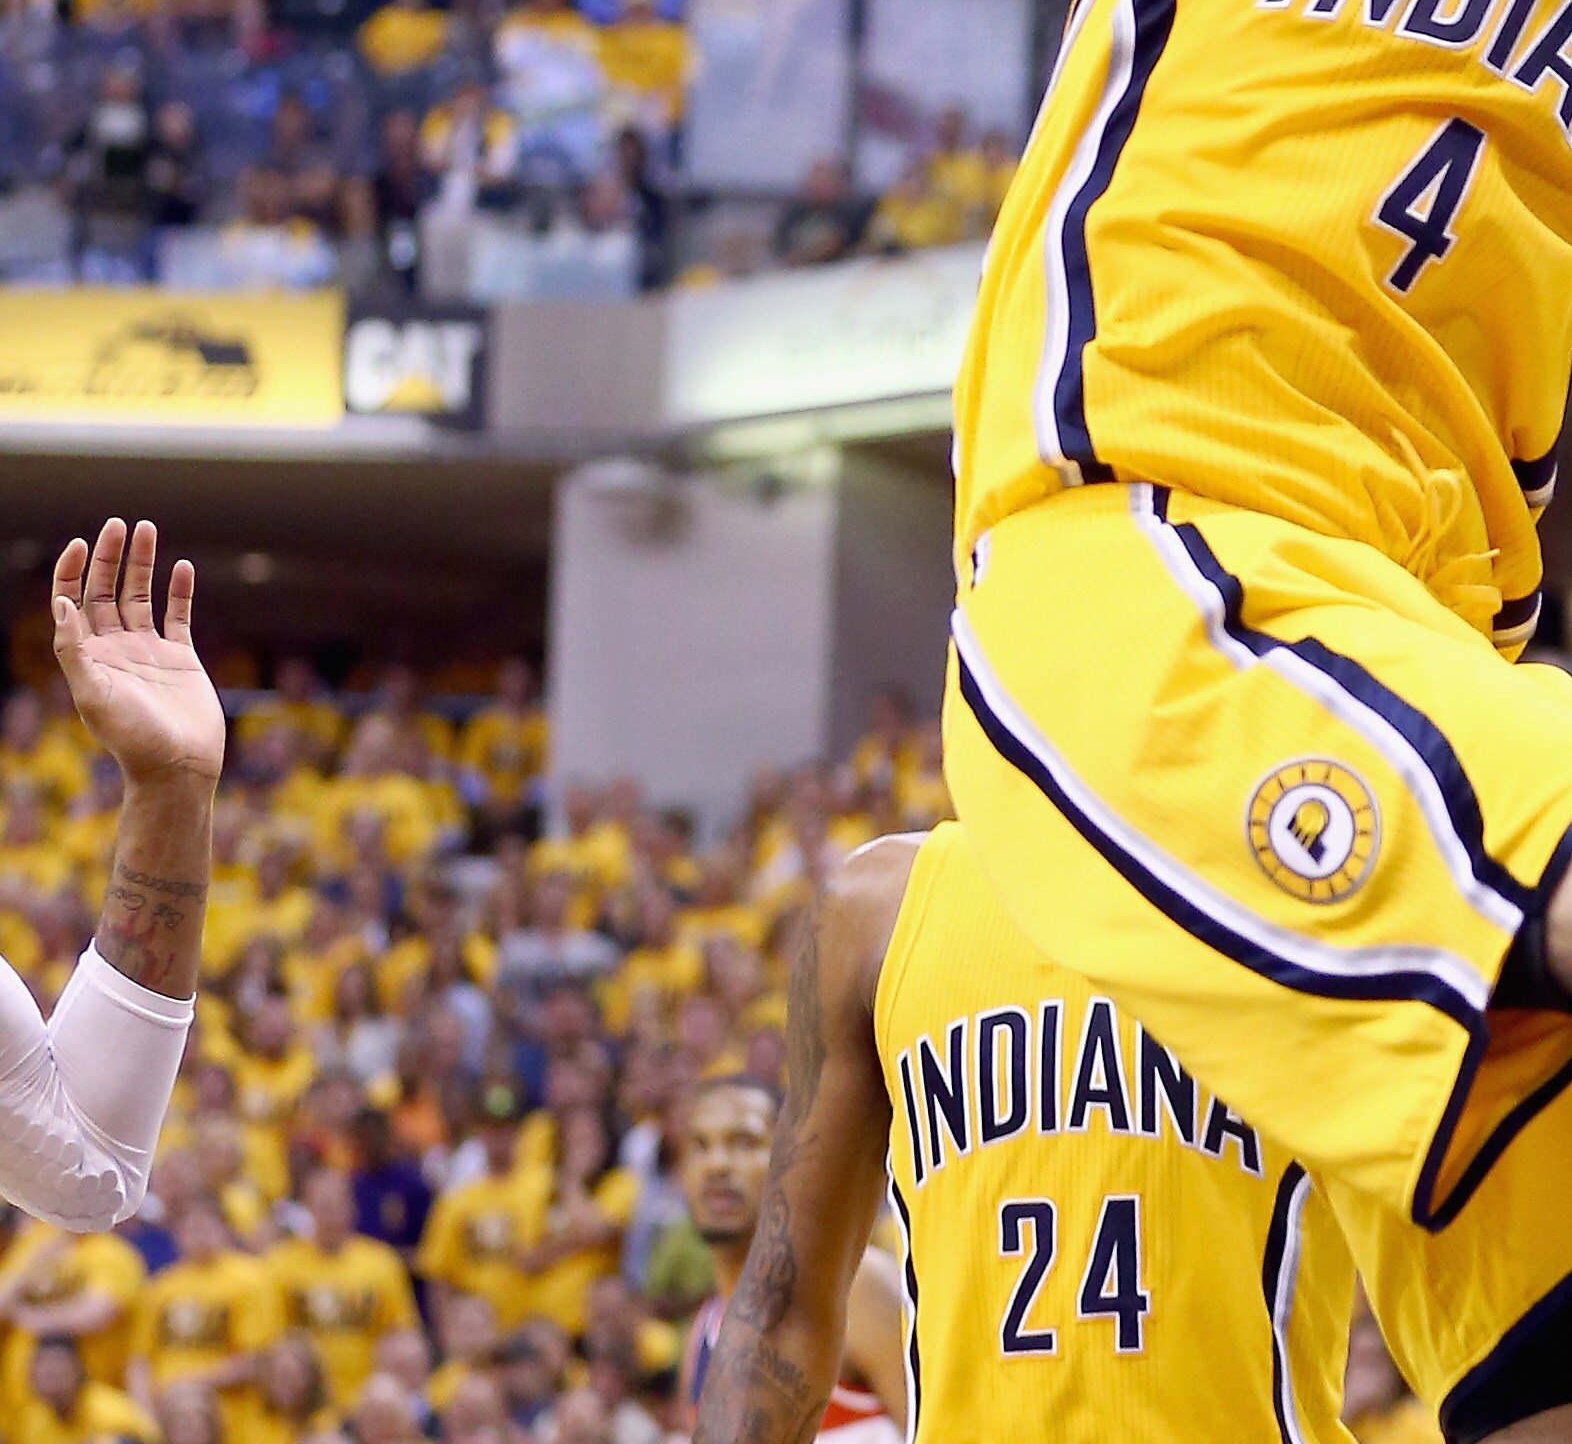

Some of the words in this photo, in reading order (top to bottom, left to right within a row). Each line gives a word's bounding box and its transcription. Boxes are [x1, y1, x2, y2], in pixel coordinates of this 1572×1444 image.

[1369, 116, 1486, 294] 4
[347, 317, 481, 413] CAT
[999, 1193, 1152, 1358] 24
